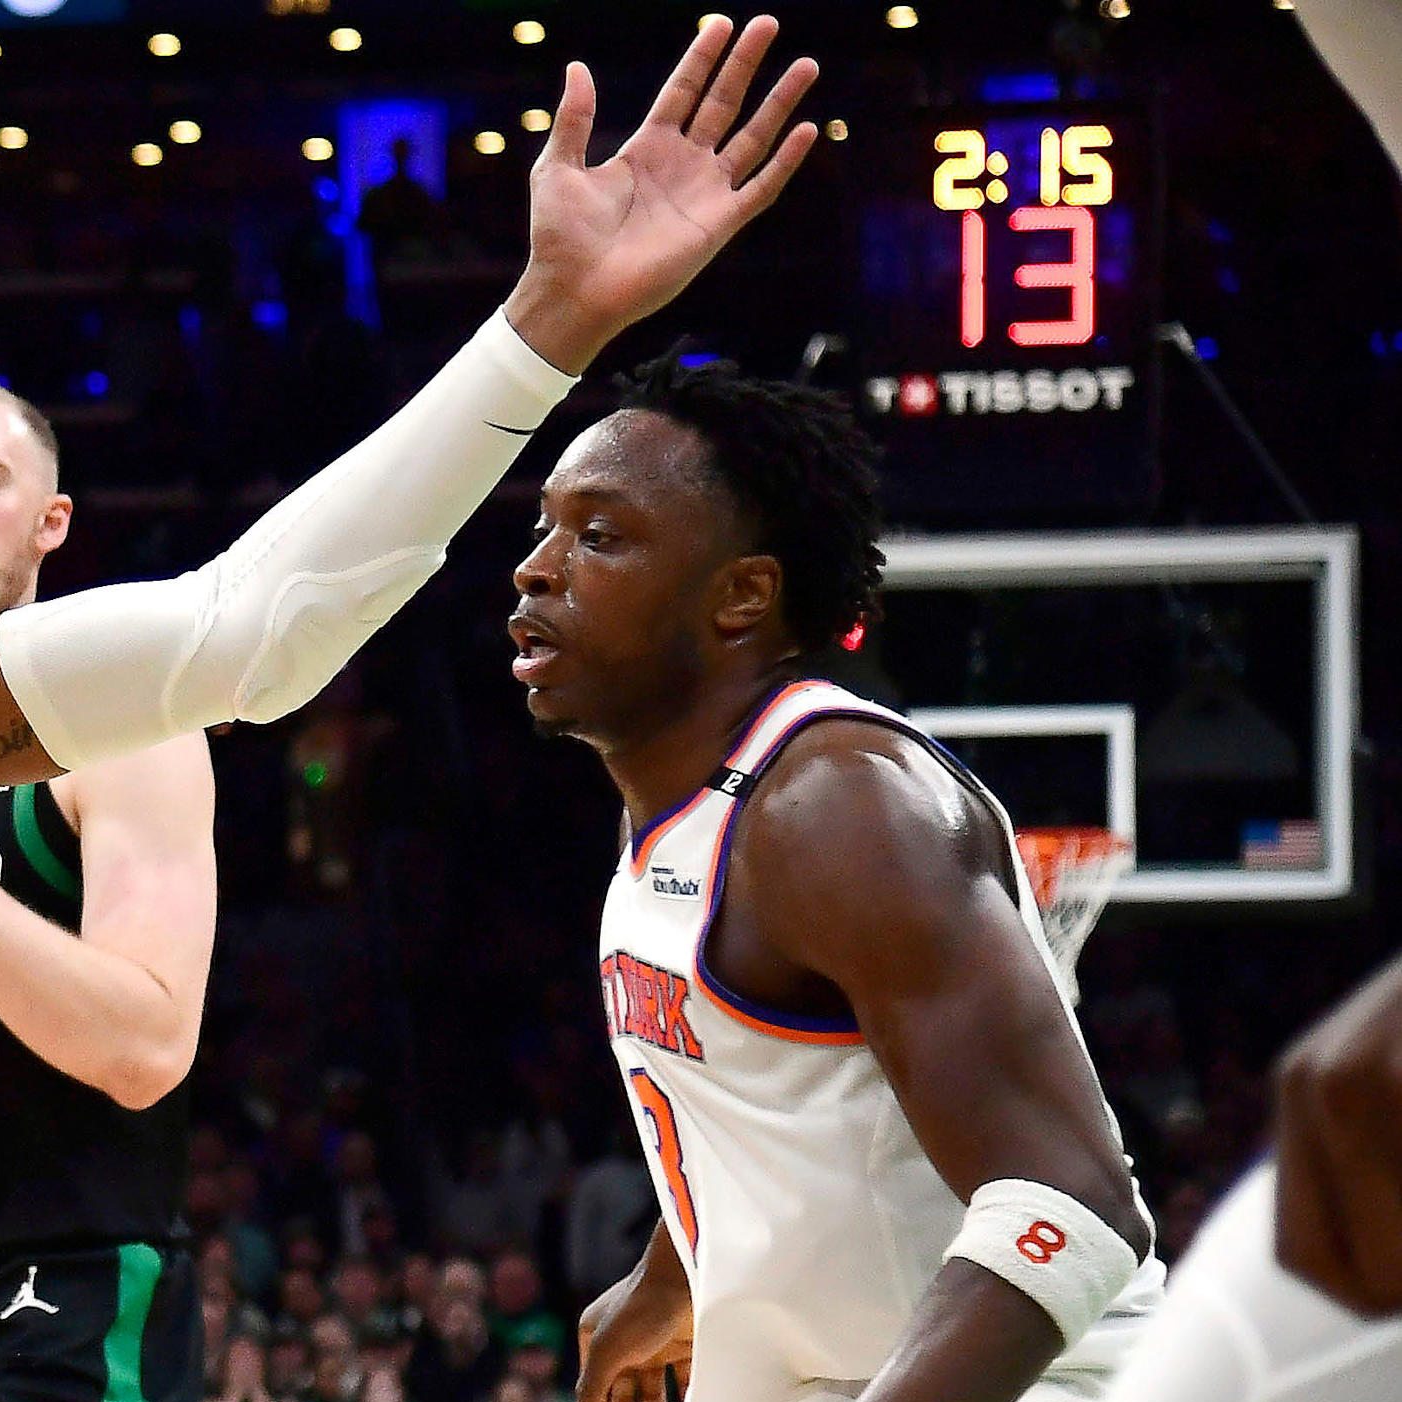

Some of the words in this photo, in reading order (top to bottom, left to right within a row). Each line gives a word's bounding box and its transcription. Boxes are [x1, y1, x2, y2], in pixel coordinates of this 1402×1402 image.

[933, 125, 1113, 210] 2:15
[961, 206, 1094, 348] 13
[1015, 1220, 1067, 1264] 8
